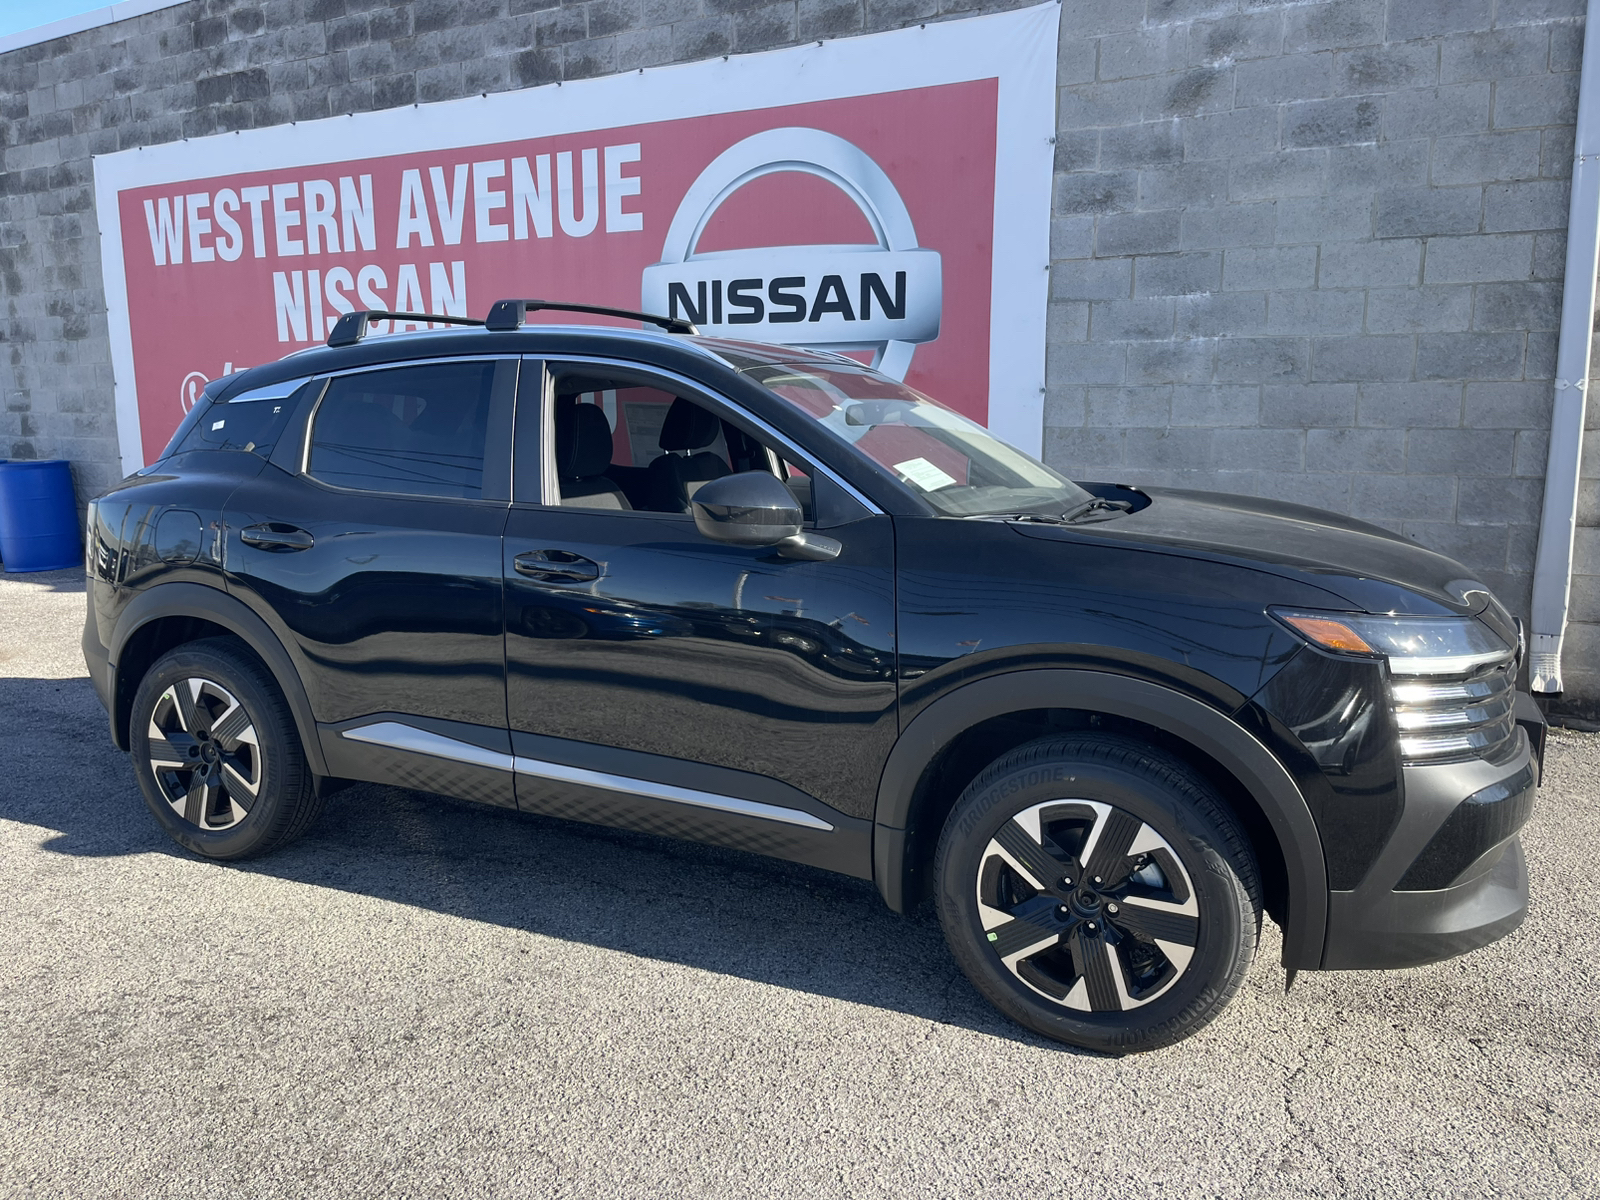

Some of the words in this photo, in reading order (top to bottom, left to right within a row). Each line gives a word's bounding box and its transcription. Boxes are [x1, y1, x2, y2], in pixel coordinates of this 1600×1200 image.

[143, 174, 377, 266] WESTERN
[396, 142, 643, 248] AVENUE
[273, 260, 468, 343] NISSAN
[668, 270, 906, 325] NISSAN
[958, 766, 1064, 839] BRIDGESTONE
